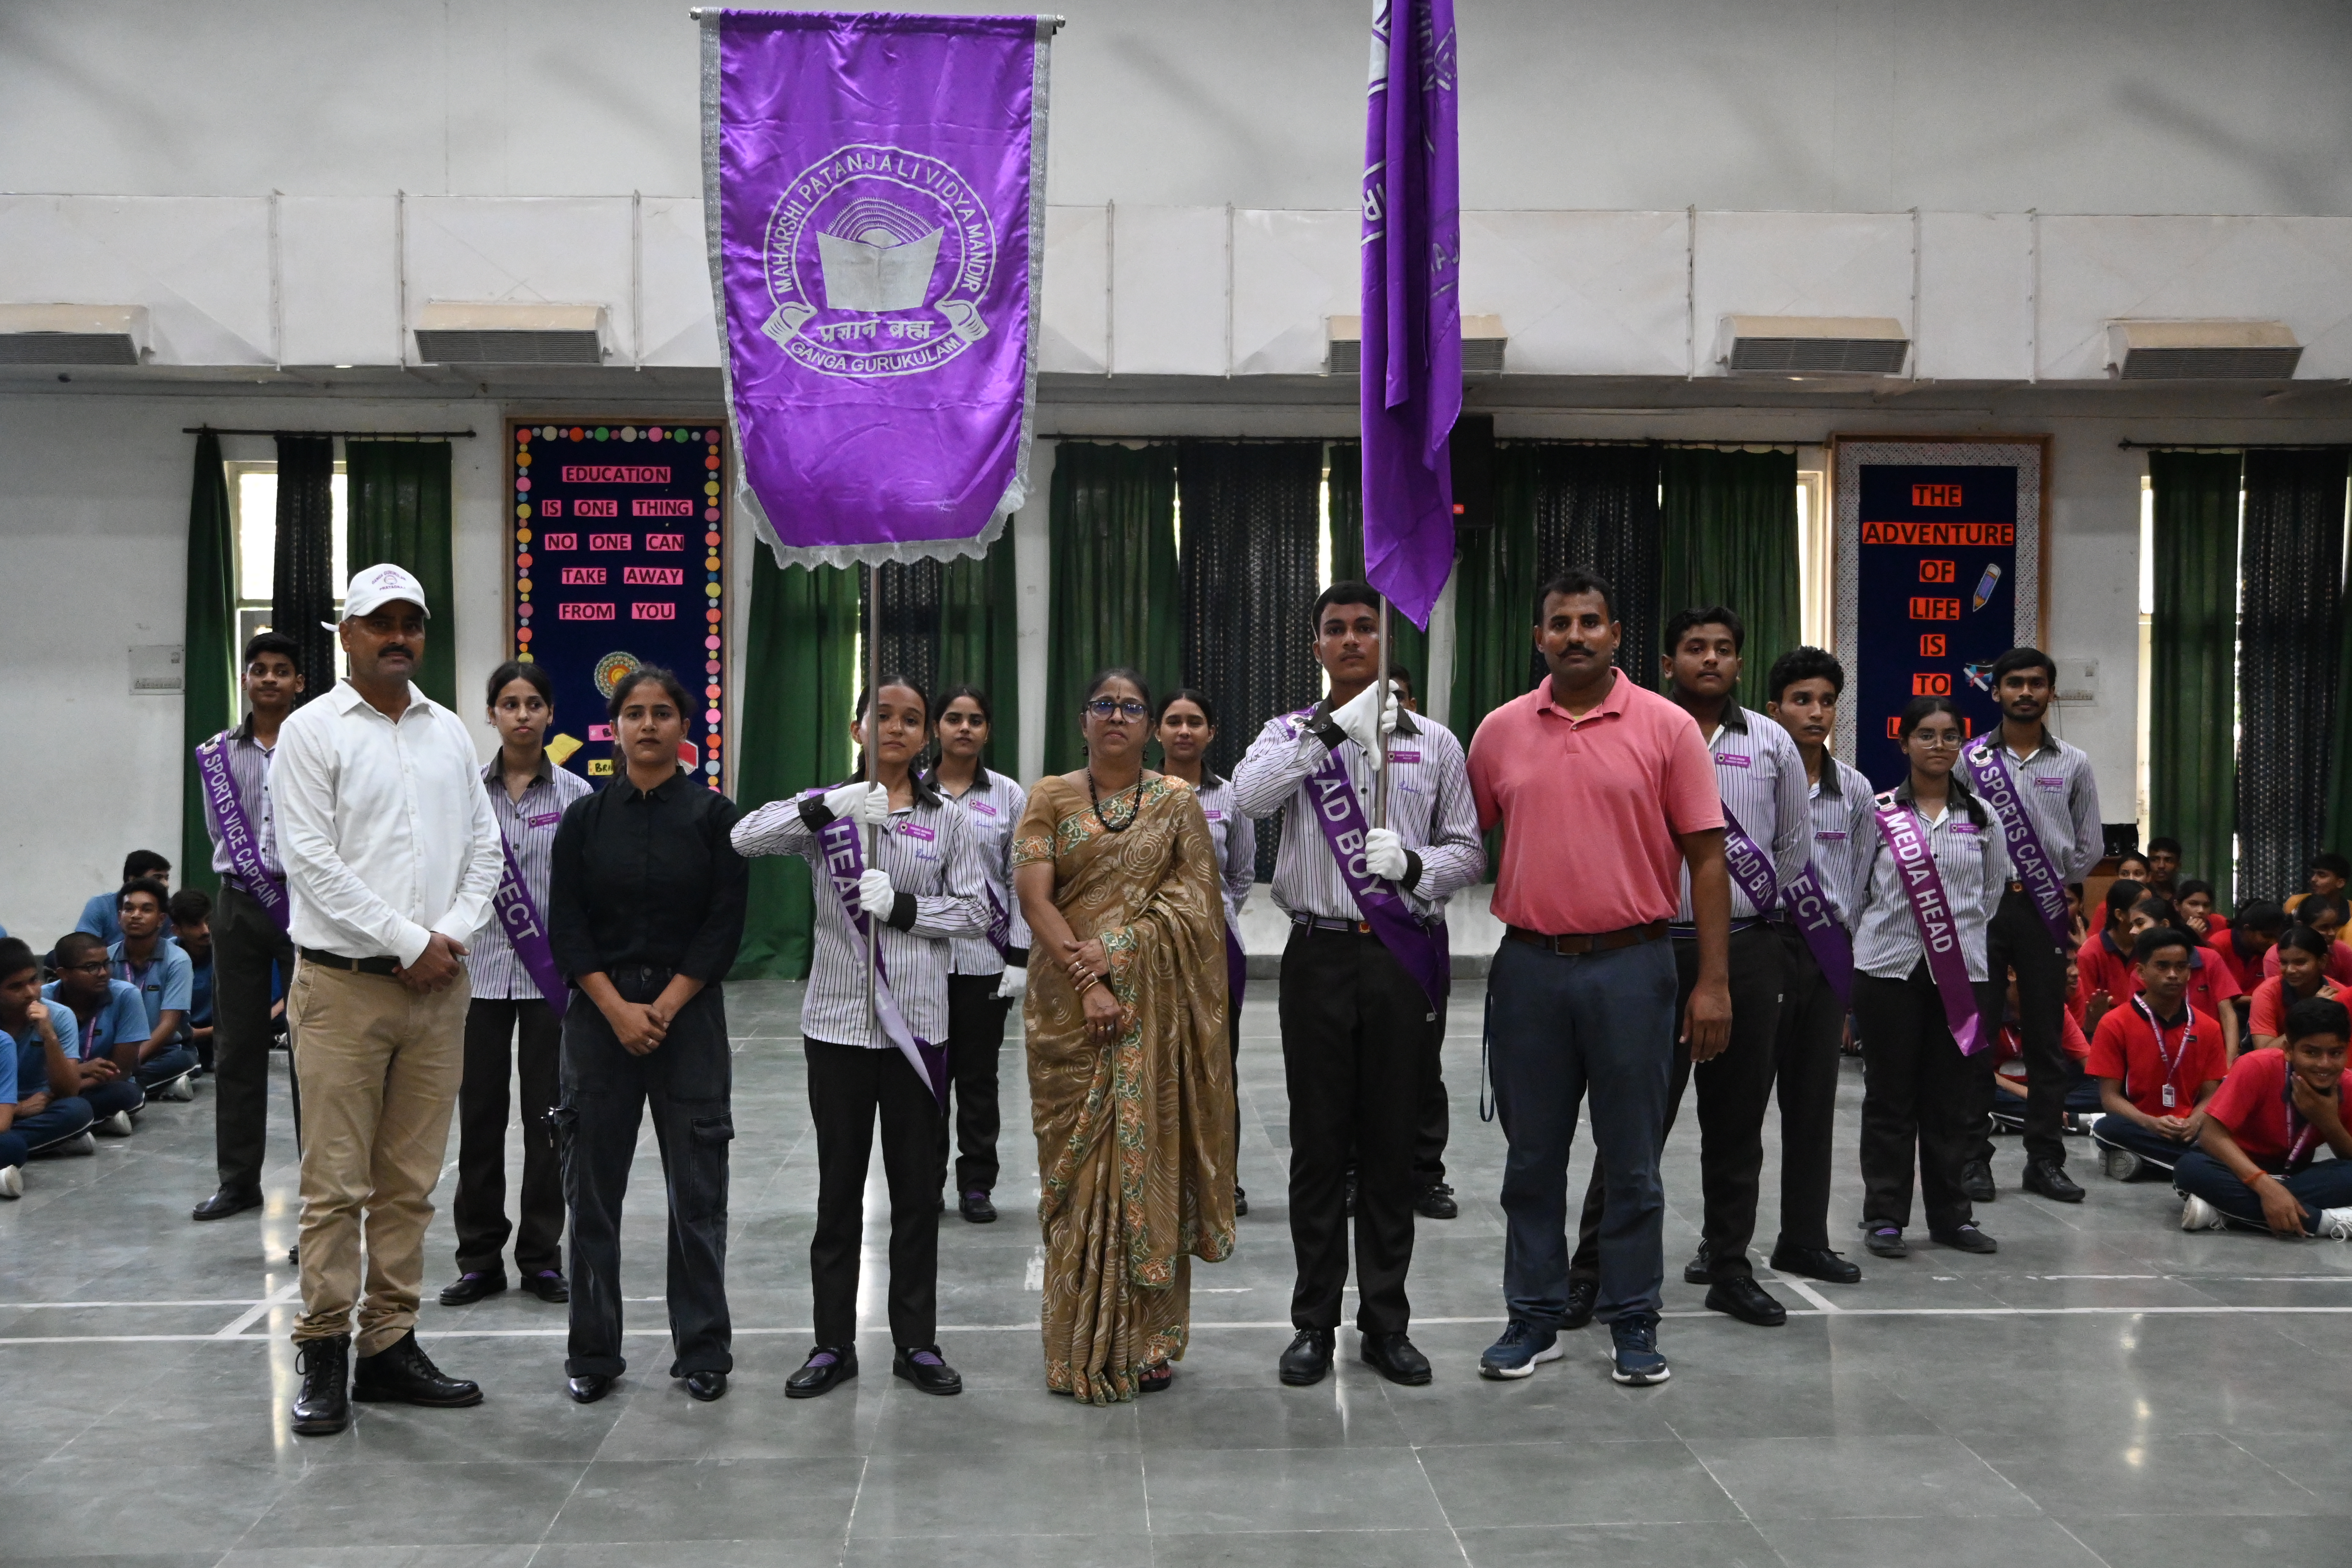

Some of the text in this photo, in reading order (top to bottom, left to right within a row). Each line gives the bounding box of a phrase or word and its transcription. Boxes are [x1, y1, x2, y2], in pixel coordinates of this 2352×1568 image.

[770, 153, 987, 294] MAHARSHI PATANJALI VIDYA MANDIR
[886, 320, 934, 339] ब्रह्म
[790, 338, 962, 372] GANGA GURUKULAM
[566, 467, 668, 482] EDUCATION
[1914, 486, 1960, 506] THE
[544, 501, 689, 515] IS ONE THING
[548, 536, 683, 550] NO ONE CAN
[1865, 523, 2013, 544] ADVENTURE
[563, 569, 680, 584] TAKE AWAY
[1921, 562, 1953, 582] OF
[563, 605, 672, 619] FROM YOU
[1913, 599, 1958, 619] LIFE
[1923, 636, 1943, 655] IS
[1916, 675, 1949, 694] TO
[595, 762, 613, 773] BRI
[204, 753, 281, 908] SPORTS VICE CAPTAIN
[1312, 752, 1388, 896] EAD BOY
[1980, 766, 2028, 844] SPORTS
[2016, 843, 2065, 921] CAPTAIN
[825, 824, 863, 922] HEAD
[1724, 831, 1773, 906] HEAD BOY
[1884, 811, 1953, 953] MEDIA HEAD
[1787, 874, 1832, 931] ECT
